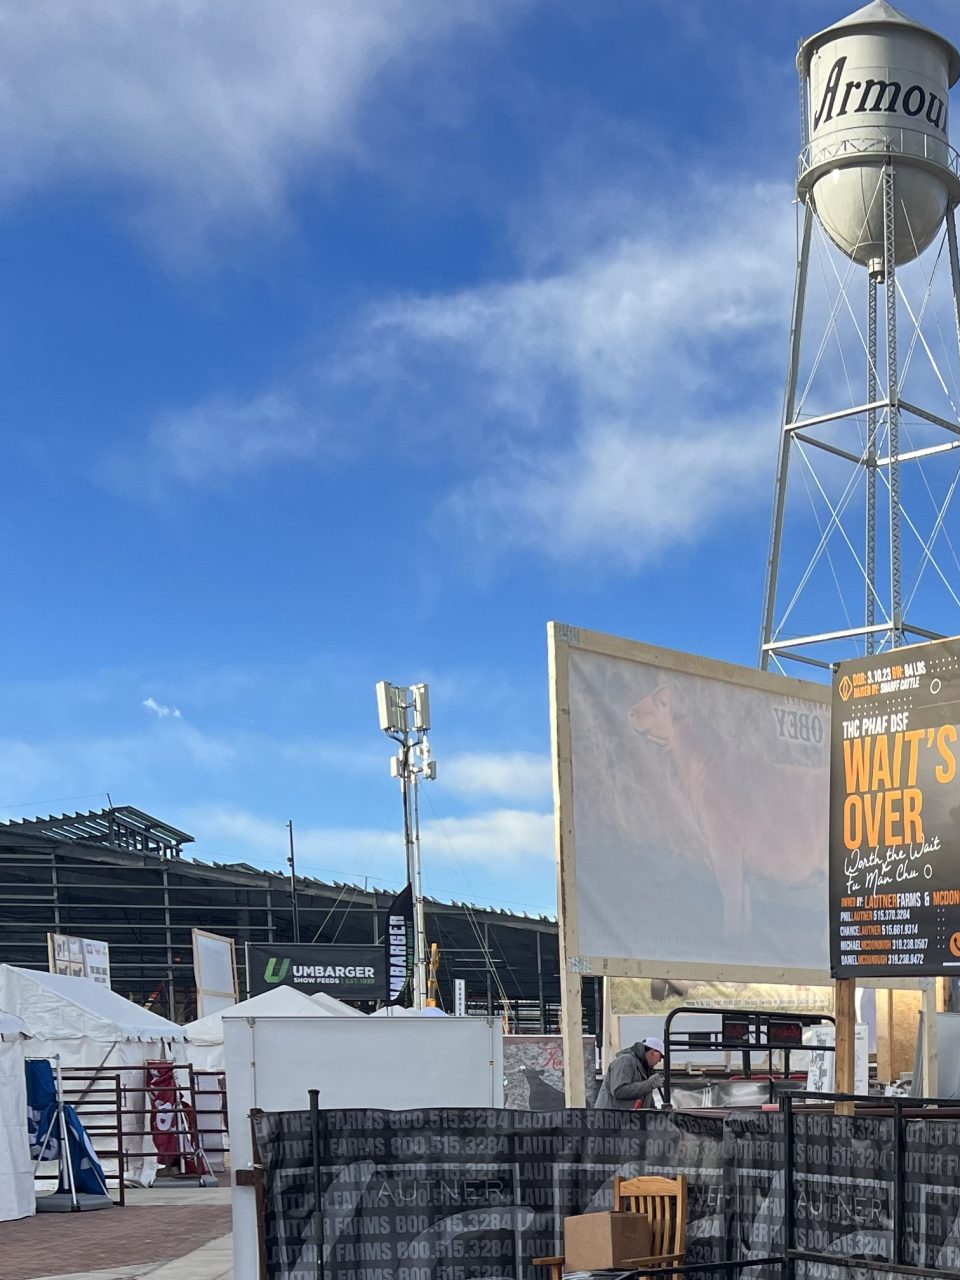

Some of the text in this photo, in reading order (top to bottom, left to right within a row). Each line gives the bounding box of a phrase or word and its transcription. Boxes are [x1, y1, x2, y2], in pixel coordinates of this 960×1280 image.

[813, 56, 948, 133] Armou
[842, 712, 909, 739] THC PHAF DSF
[843, 788, 923, 850] OVER
[844, 832, 941, 876] Worth the Wait
[895, 859, 919, 882] Chu
[292, 965, 375, 978] UMBARGER
